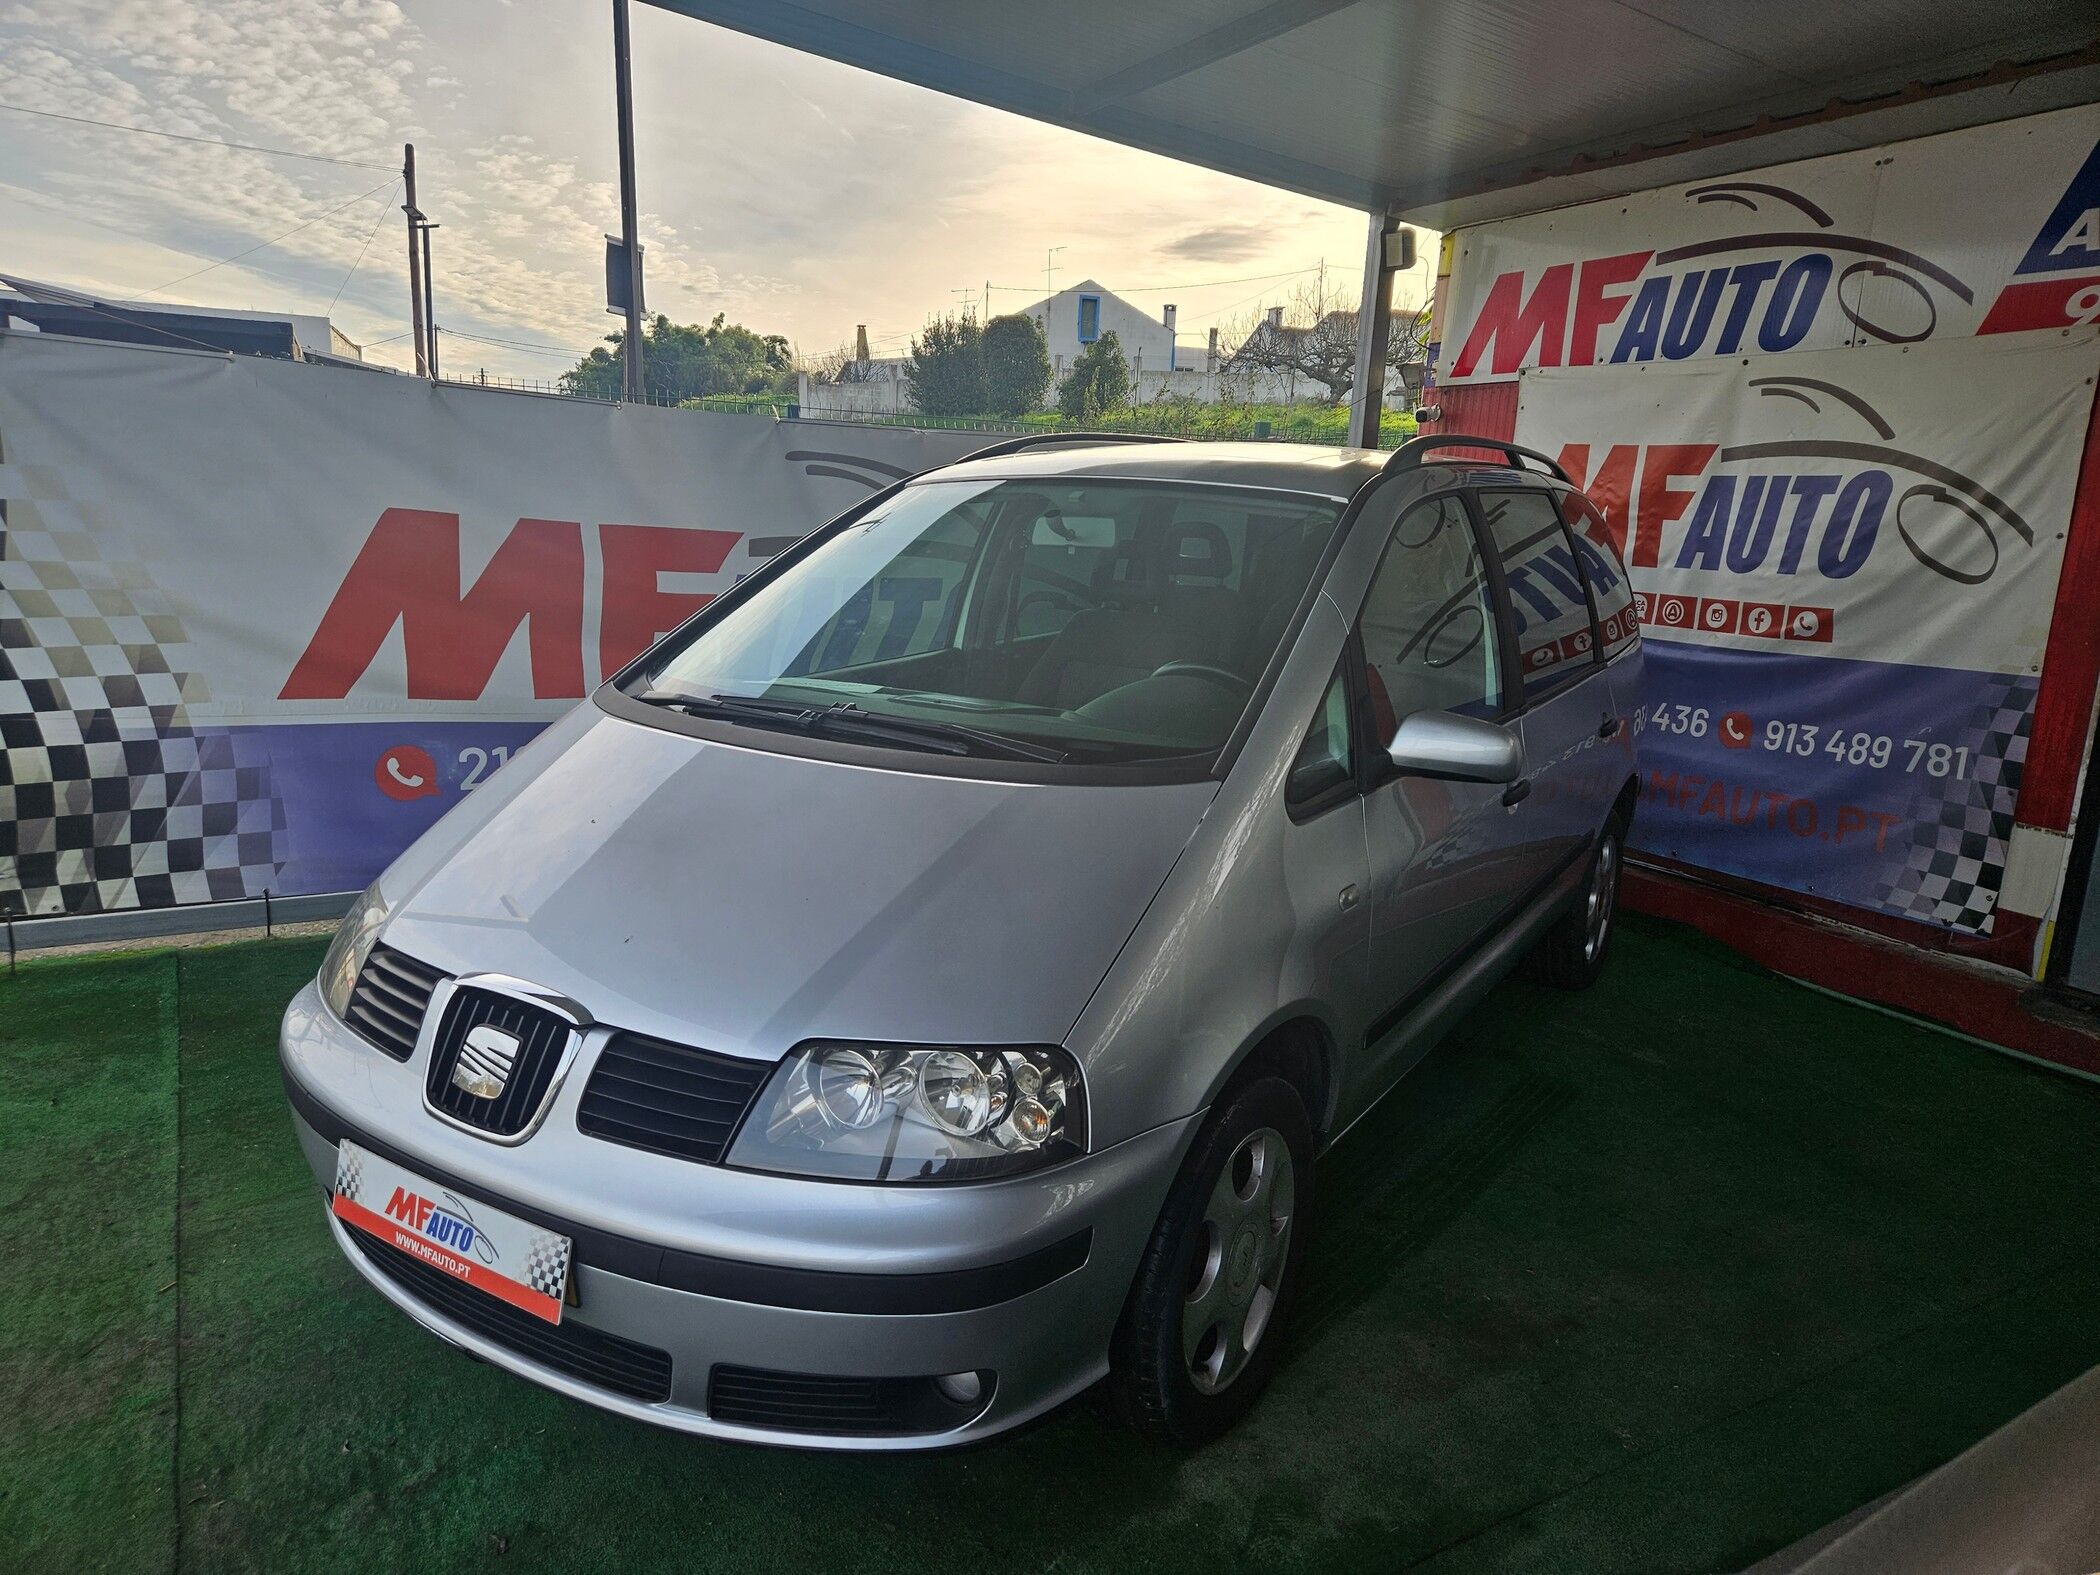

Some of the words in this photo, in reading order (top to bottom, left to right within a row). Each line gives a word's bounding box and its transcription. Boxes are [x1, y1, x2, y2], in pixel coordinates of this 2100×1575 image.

[1652, 702, 1710, 737] 436
[1763, 719, 1820, 757] 913
[1824, 730, 1893, 768] 489
[1903, 738, 1969, 780] 781
[395, 1231, 471, 1278] WWW.MFAUTO.PT
